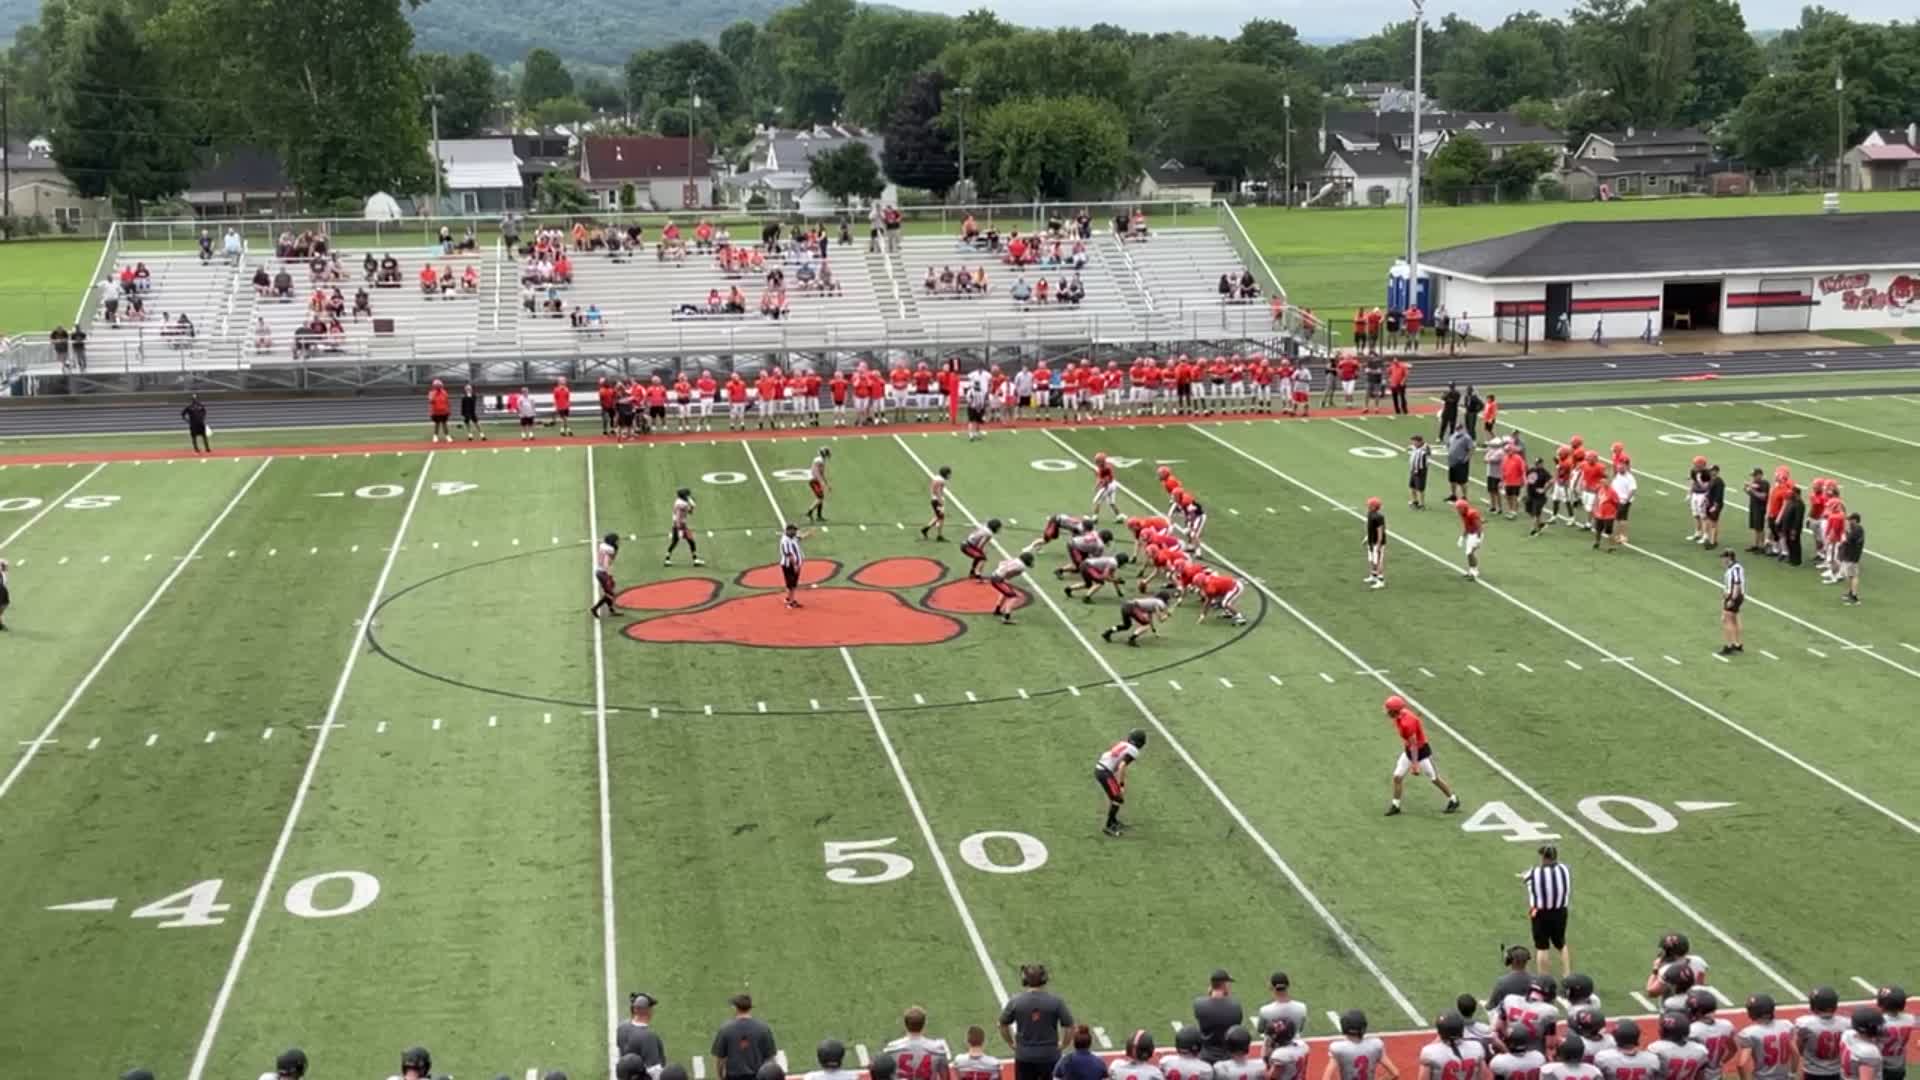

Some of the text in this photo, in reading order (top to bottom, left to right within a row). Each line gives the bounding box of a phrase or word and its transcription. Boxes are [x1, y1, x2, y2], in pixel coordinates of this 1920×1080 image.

[1461, 795, 1678, 842] 40
[824, 830, 1048, 884] 50
[131, 870, 381, 928] 40
